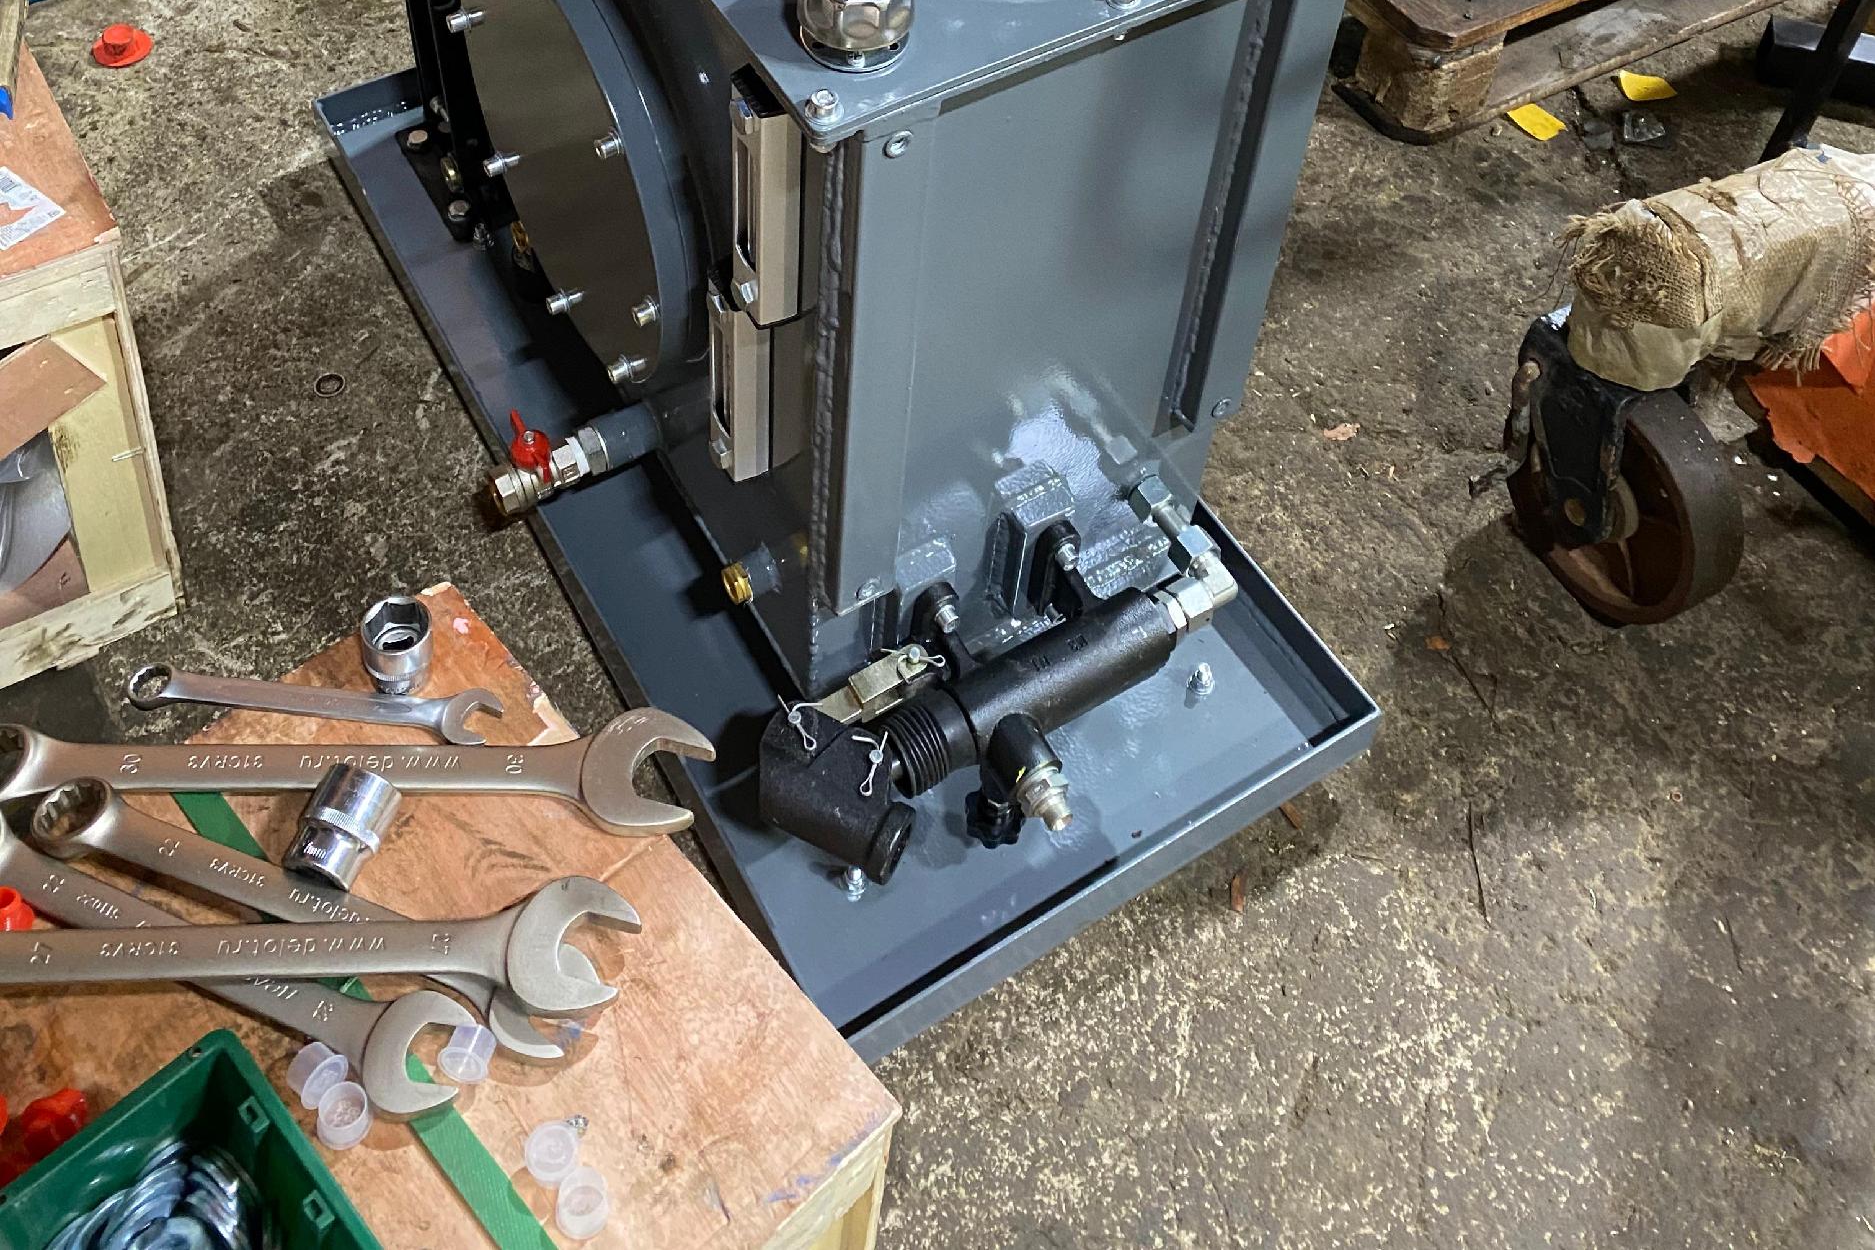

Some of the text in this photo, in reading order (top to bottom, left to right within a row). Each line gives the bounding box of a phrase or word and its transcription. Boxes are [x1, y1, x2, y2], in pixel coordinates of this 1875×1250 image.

[119, 753, 143, 775] 30
[187, 753, 264, 770] 31CRV3
[505, 753, 524, 776] 30
[287, 884, 372, 924] .delot.ru
[216, 935, 386, 957] www.delot.ru
